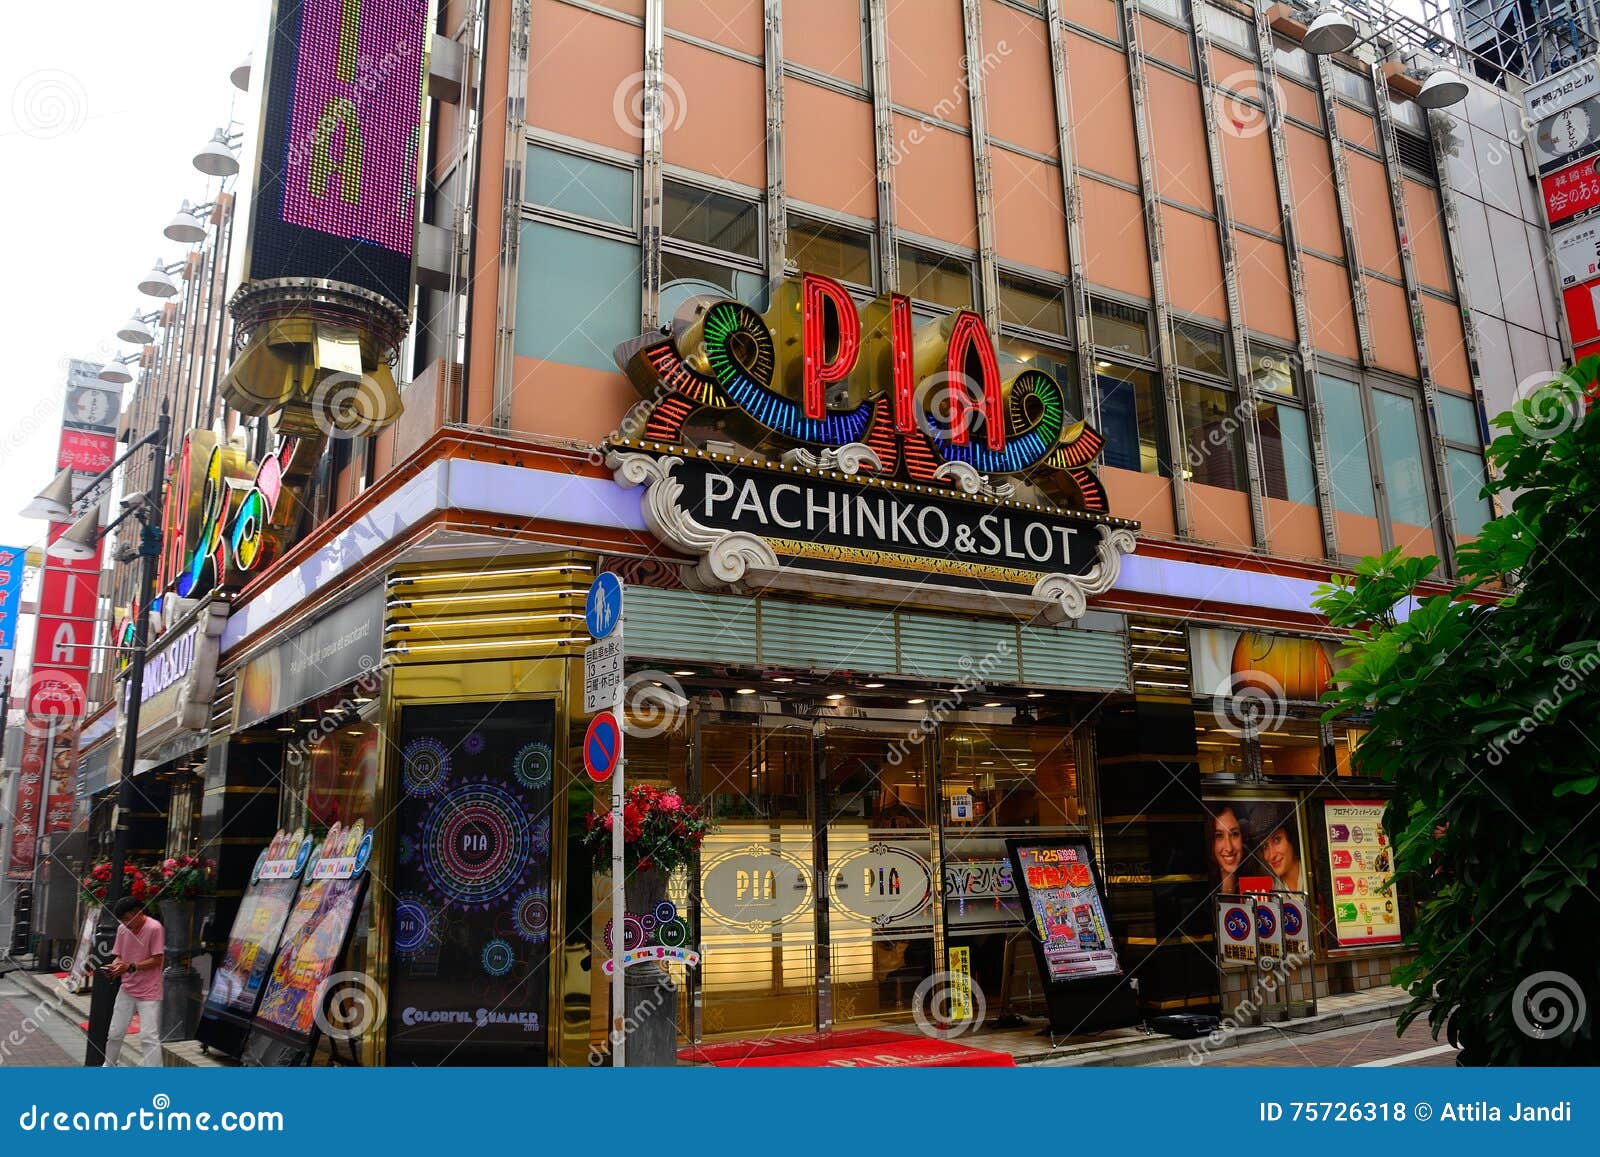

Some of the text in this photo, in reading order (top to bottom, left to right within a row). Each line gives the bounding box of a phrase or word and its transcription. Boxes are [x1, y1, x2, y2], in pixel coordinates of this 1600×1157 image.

[803, 272, 1005, 452] PIA
[463, 834, 488, 852] PIA
[736, 869, 777, 900] PIA
[863, 867, 900, 897] PIA
